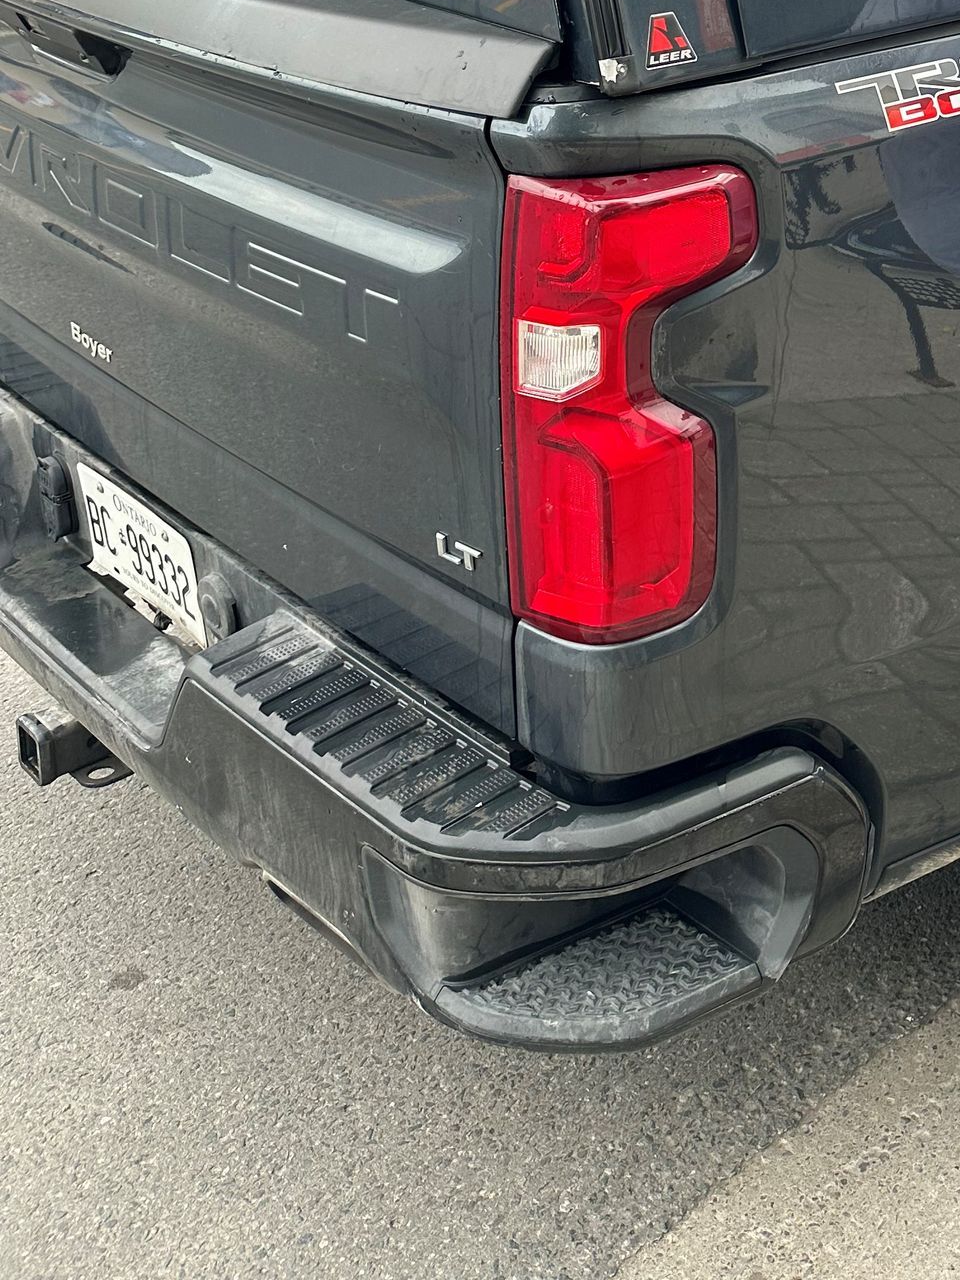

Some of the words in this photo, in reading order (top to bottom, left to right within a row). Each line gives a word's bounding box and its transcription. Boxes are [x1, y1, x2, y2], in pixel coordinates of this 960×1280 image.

[649, 49, 692, 65] LEER
[70, 321, 113, 363] Boyer
[112, 493, 157, 537] ONTARIO
[435, 531, 482, 571] LT
